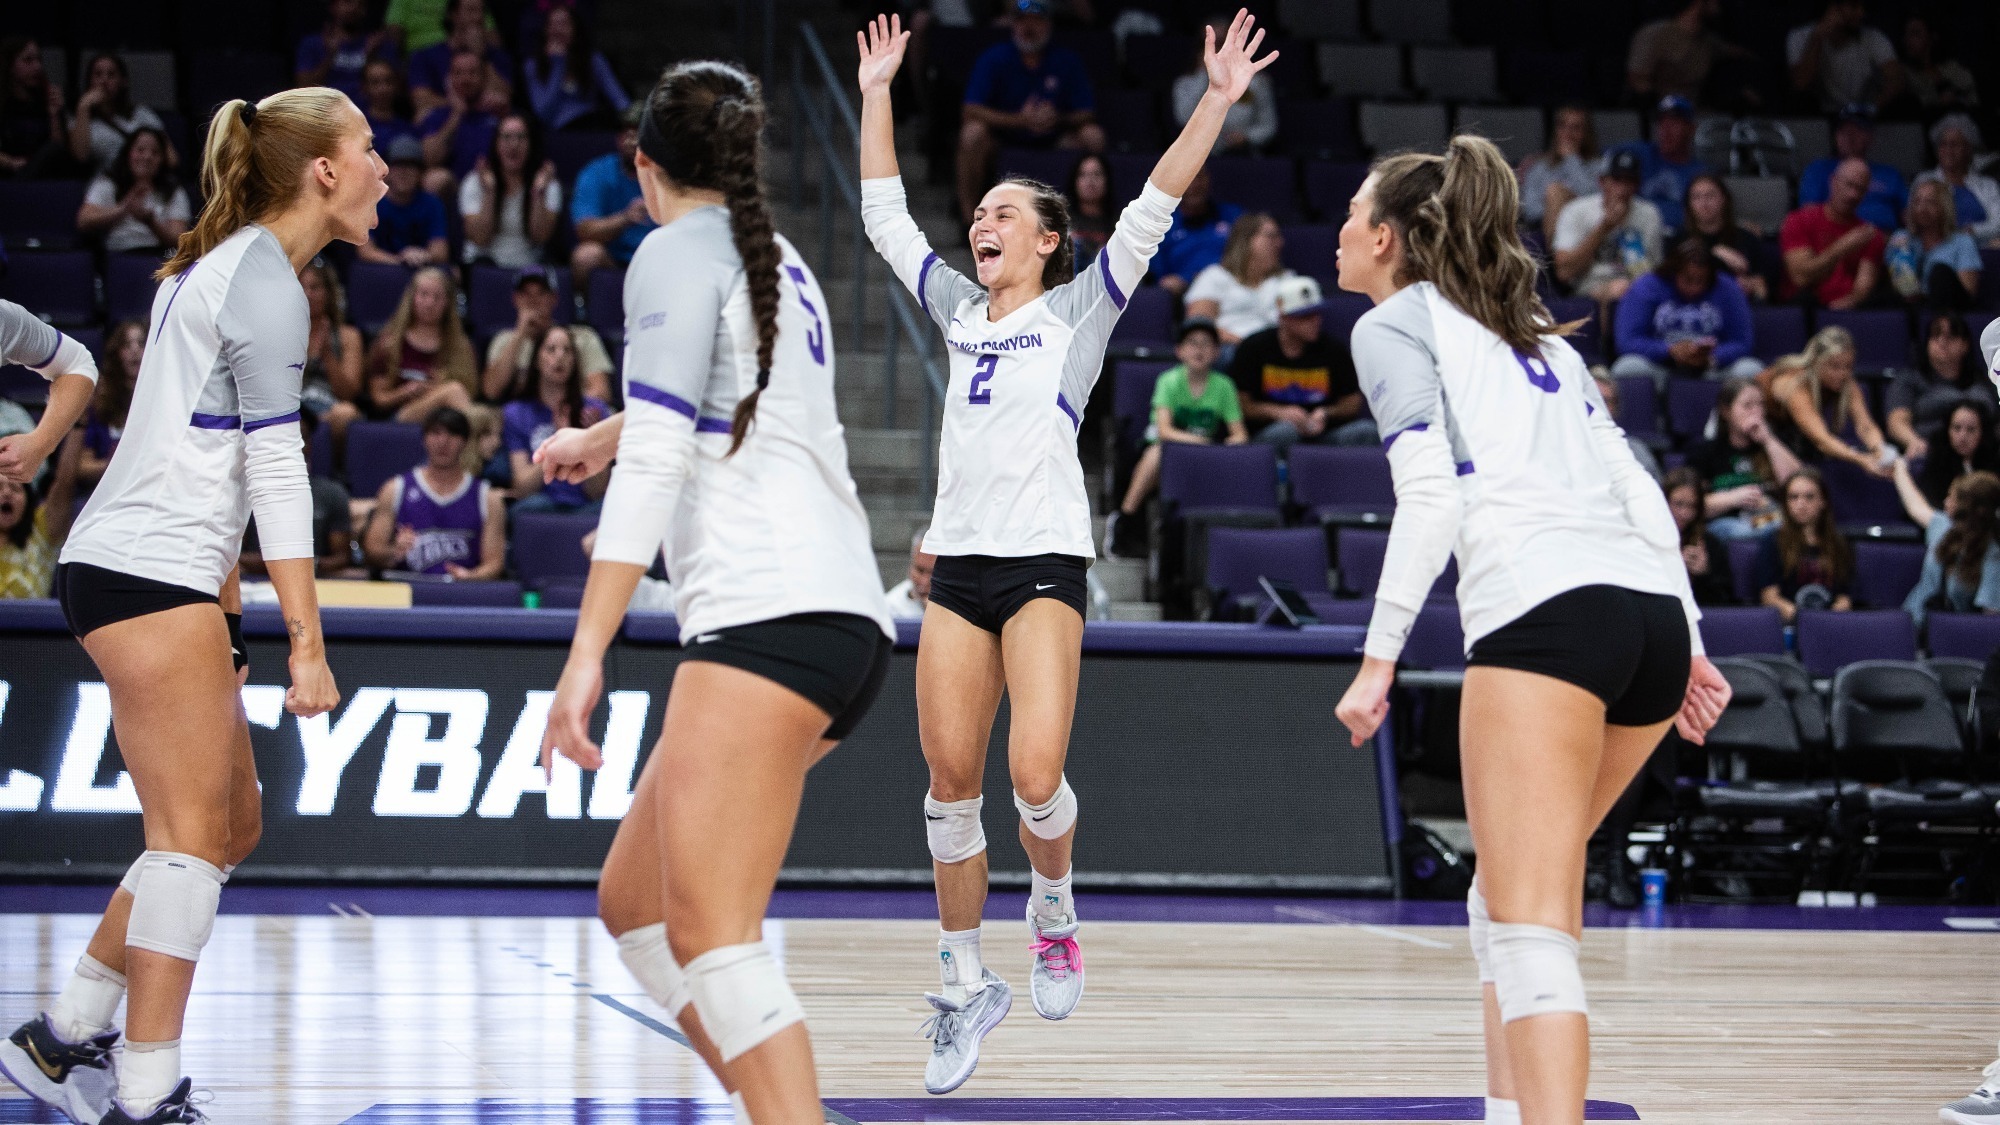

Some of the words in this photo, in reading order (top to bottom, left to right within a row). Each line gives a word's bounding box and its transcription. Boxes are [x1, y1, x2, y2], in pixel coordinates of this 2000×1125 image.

[155, 262, 199, 345] 7
[785, 264, 825, 367] 5
[981, 332, 1043, 351] CANYON
[968, 354, 999, 404] 2
